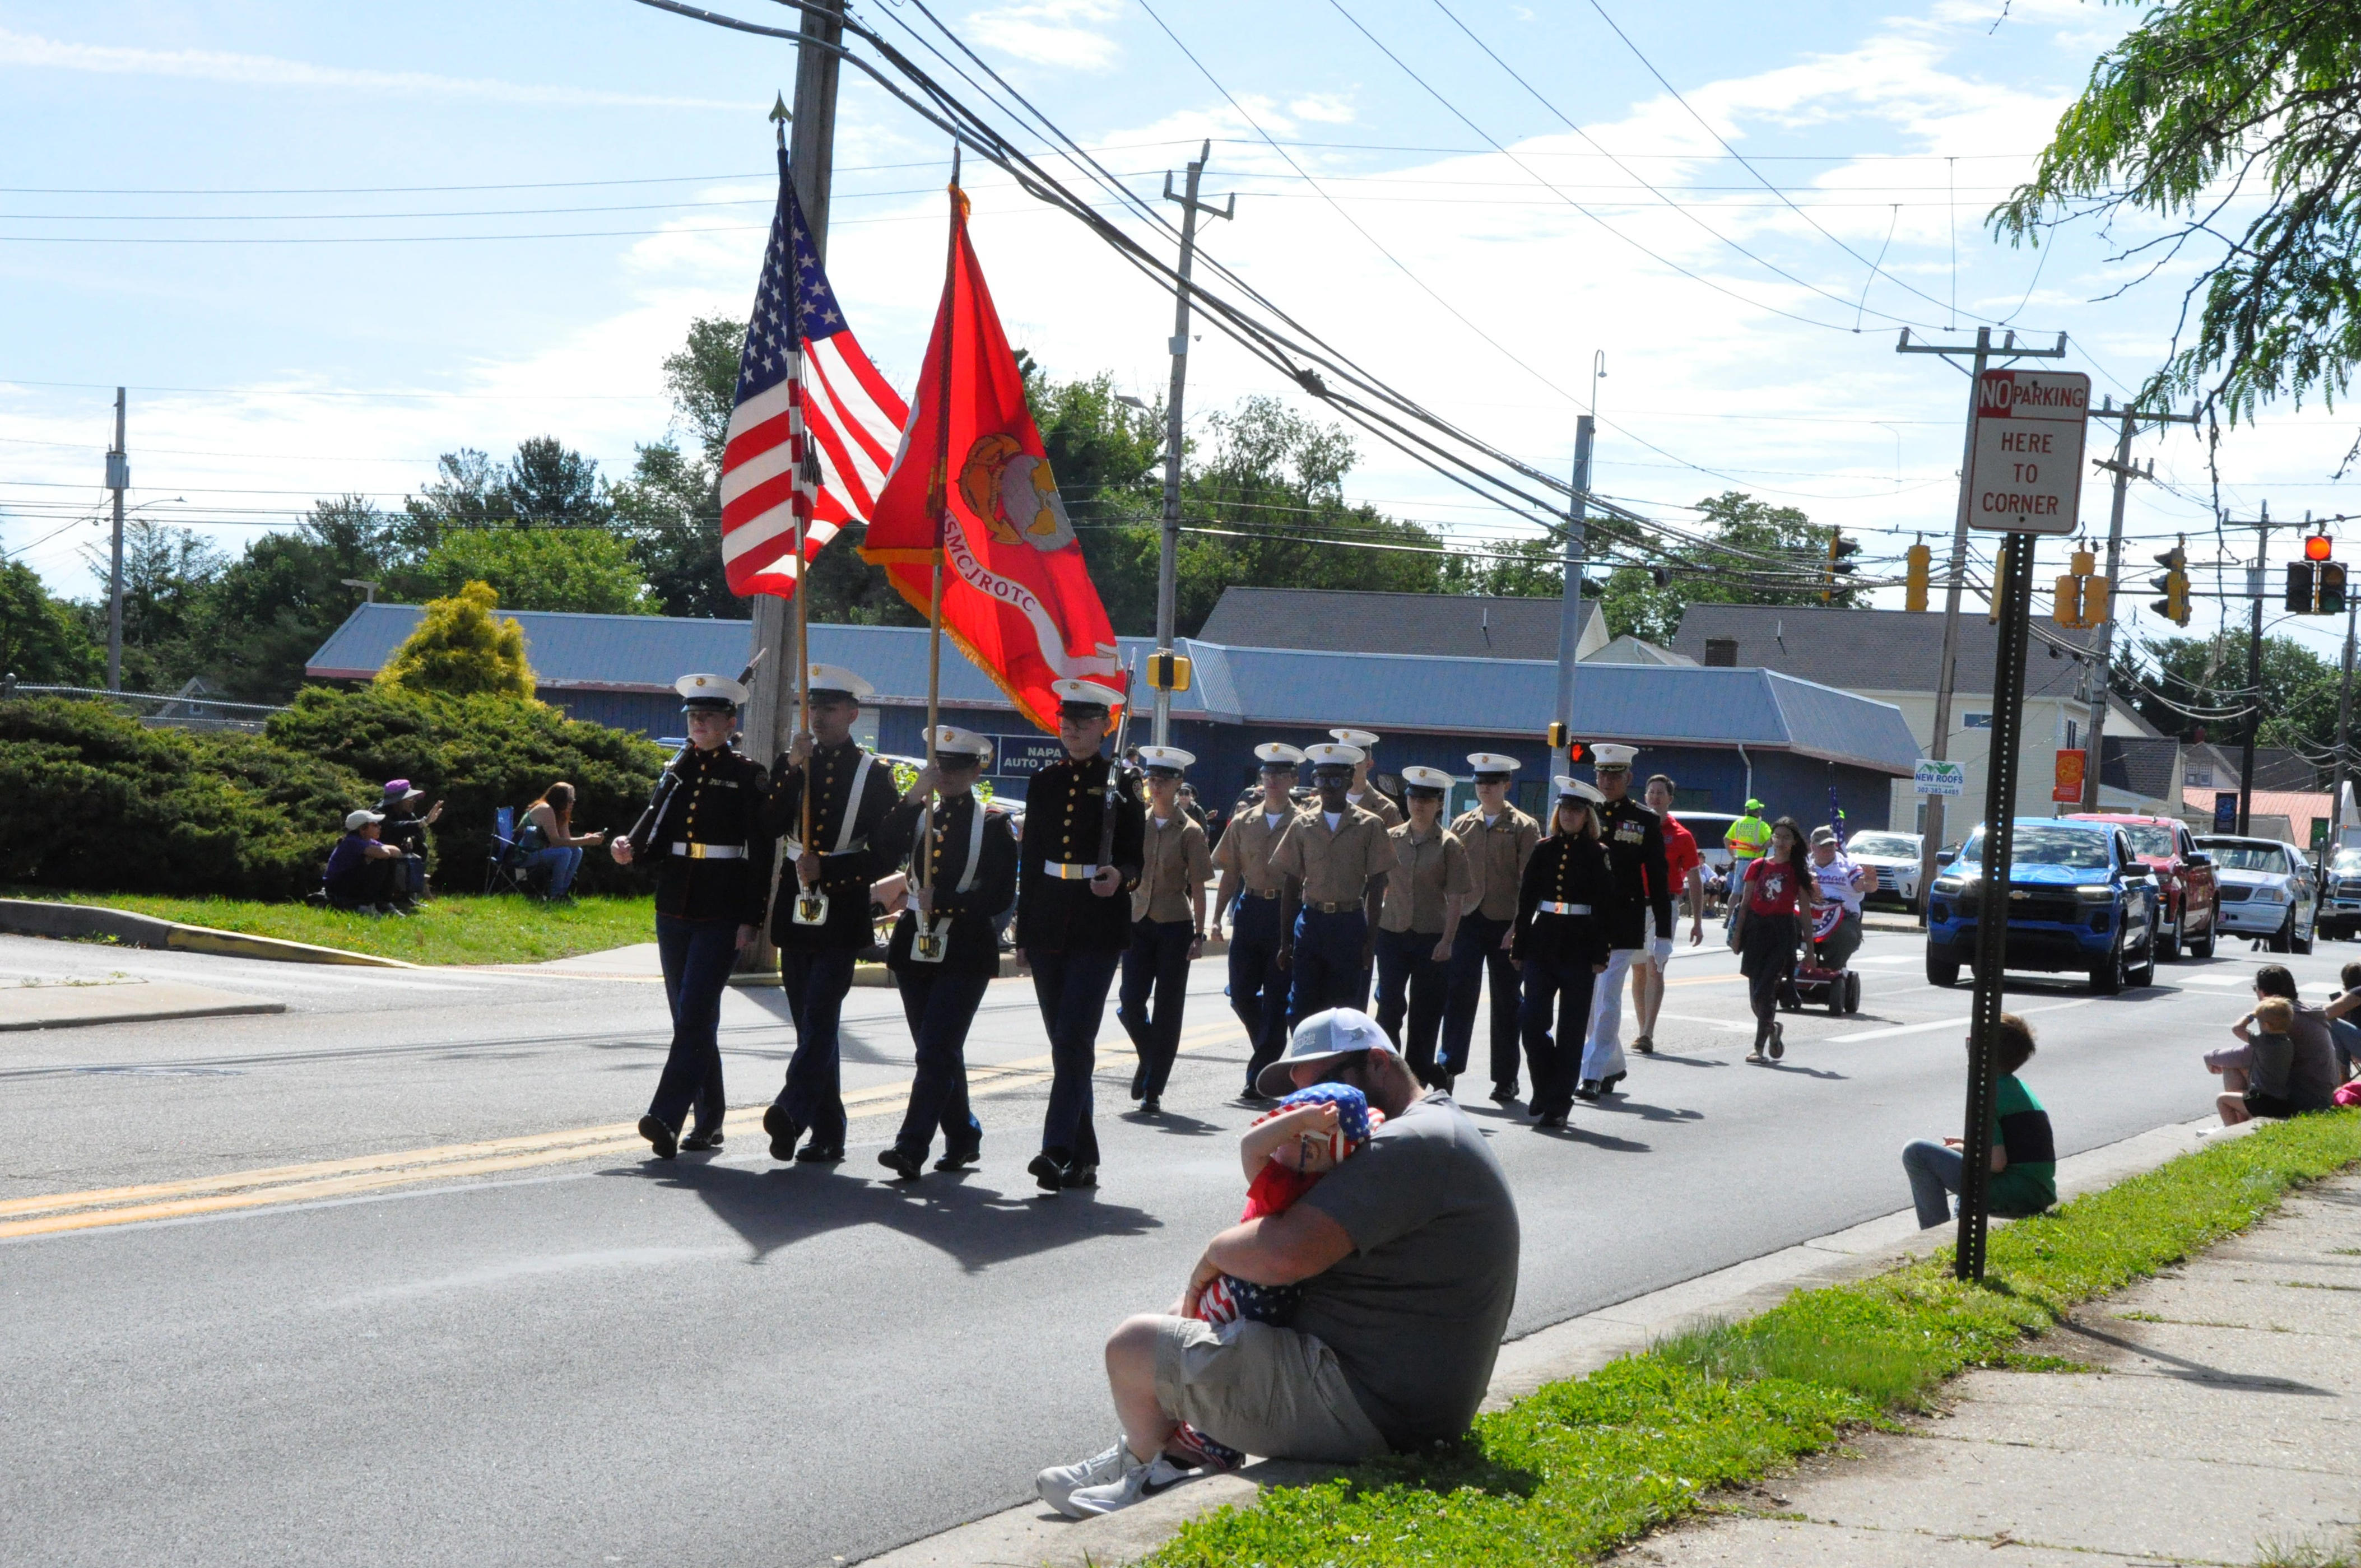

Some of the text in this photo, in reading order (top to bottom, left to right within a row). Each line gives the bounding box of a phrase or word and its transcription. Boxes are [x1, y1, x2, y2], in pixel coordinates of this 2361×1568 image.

[1979, 379, 2084, 408] NO PARKING
[2001, 432, 2053, 453] HERE
[2014, 463, 2038, 483] TO
[1982, 492, 2058, 515] CORNER
[1028, 747, 1062, 757] NAPA
[1004, 758, 1038, 768] AUTO
[1916, 774, 1963, 784] NEW ROOFS
